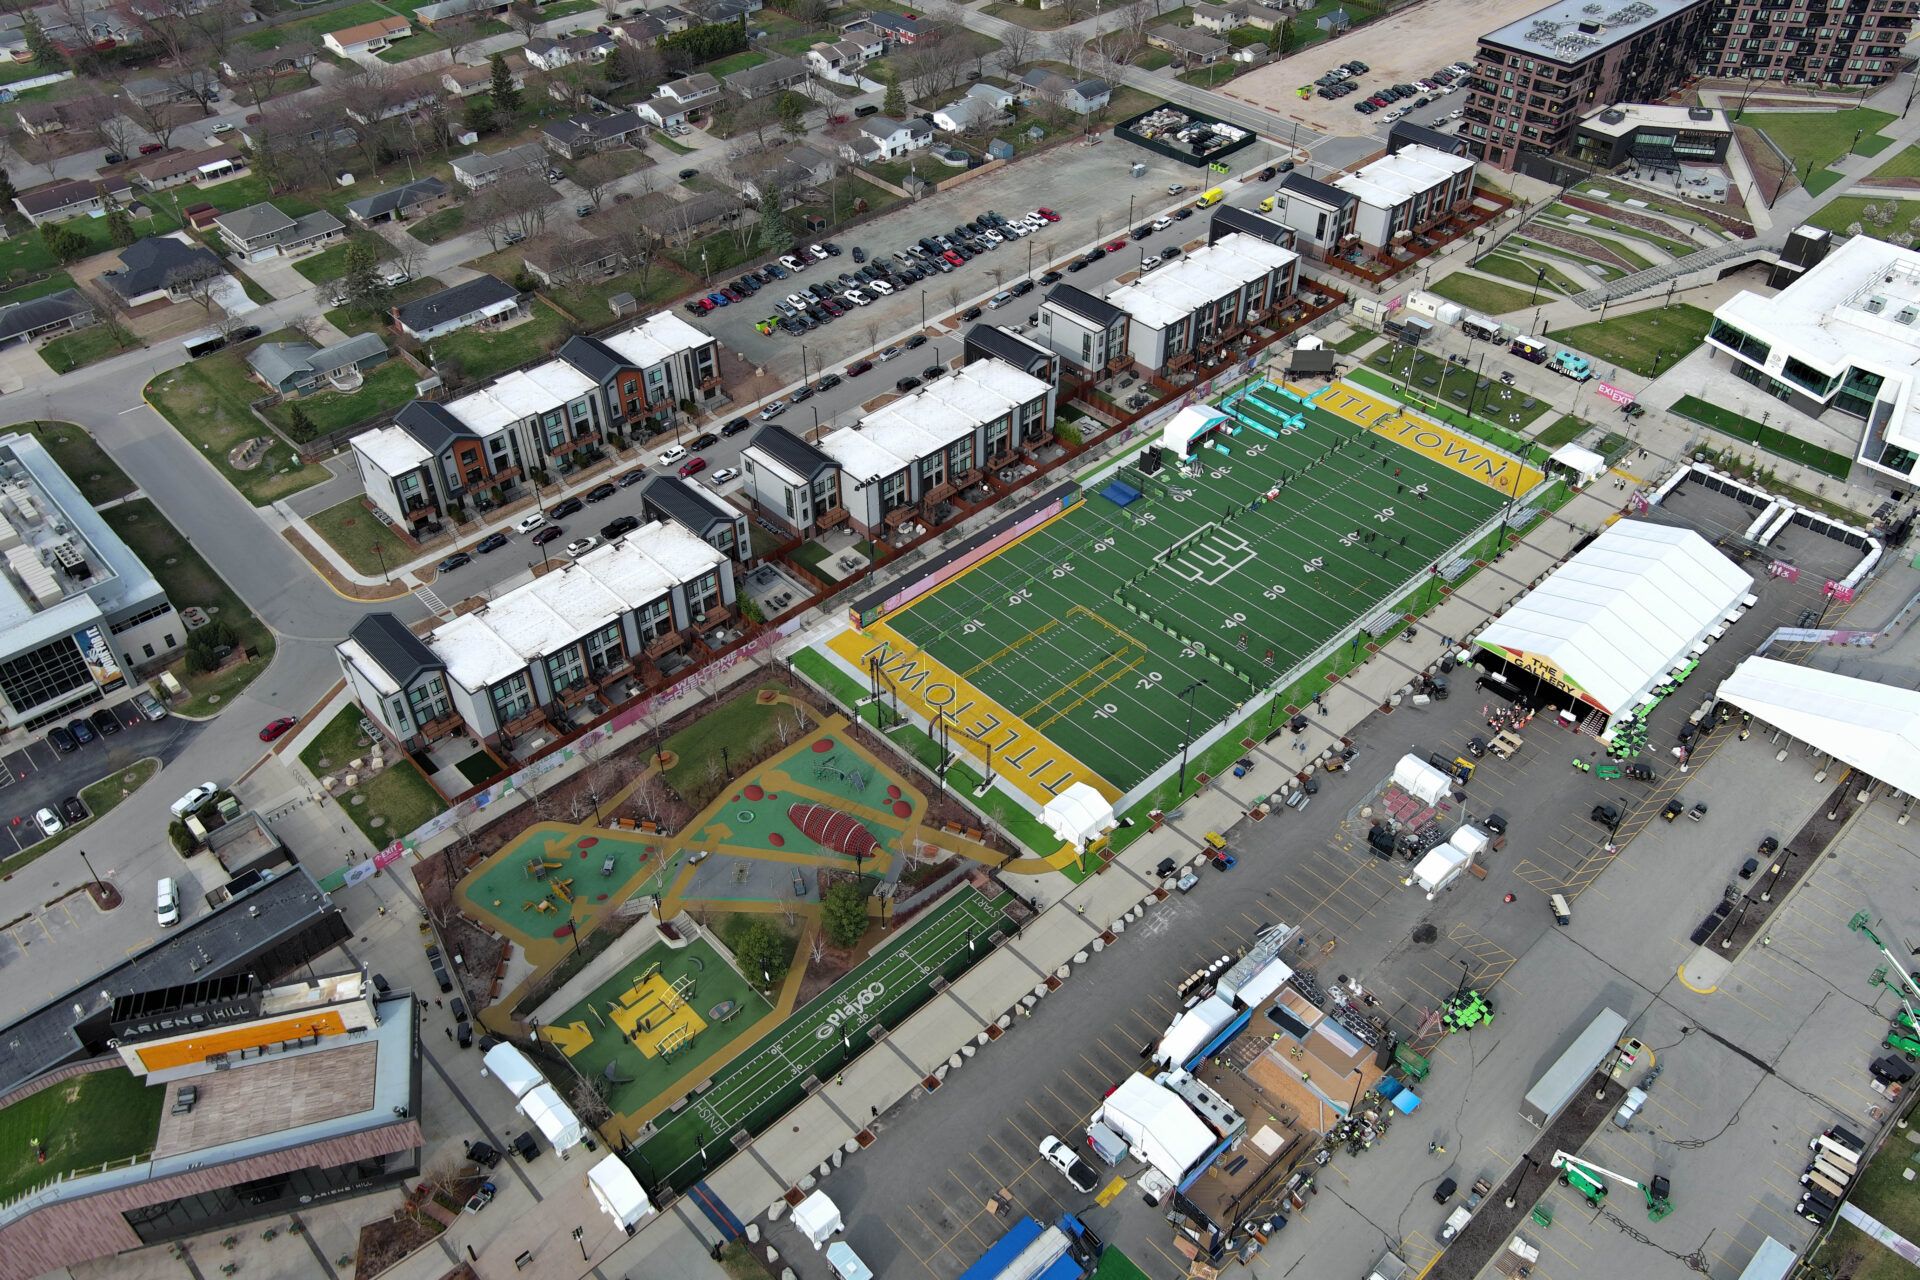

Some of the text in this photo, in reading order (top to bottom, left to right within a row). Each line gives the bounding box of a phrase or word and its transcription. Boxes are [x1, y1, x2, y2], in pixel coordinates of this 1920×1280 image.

[1598, 384, 1614, 396] EXI
[1324, 390, 1509, 478] ITLETOWN
[1246, 444, 1266, 457] 20
[1210, 466, 1230, 479] 30
[1172, 489, 1193, 502] 40
[1409, 484, 1429, 496] 10
[1374, 507, 1395, 523] 20
[1095, 536, 1116, 552] 40
[1338, 531, 1361, 548] 30
[1053, 561, 1076, 578] 30
[1303, 557, 1323, 574] 40
[1263, 584, 1286, 601] 50
[1833, 581, 1850, 594] EXIT
[1008, 588, 1033, 605] 20
[963, 618, 986, 634] 10
[1224, 612, 1247, 630] 40
[1183, 641, 1206, 659] 30
[676, 641, 758, 690] WELCOME TO
[712, 660, 736, 679] BAY
[1531, 657, 1558, 678] THE
[1139, 672, 1163, 690] 20
[1514, 658, 1576, 694] GALLERY
[864, 640, 1073, 797] TITLETOWN
[1097, 703, 1118, 719] 10
[380, 844, 399, 858] EXIT
[972, 896, 1001, 918] START
[123, 1005, 250, 1037] ARIENS HILL
[693, 1101, 726, 1135] FINISH
